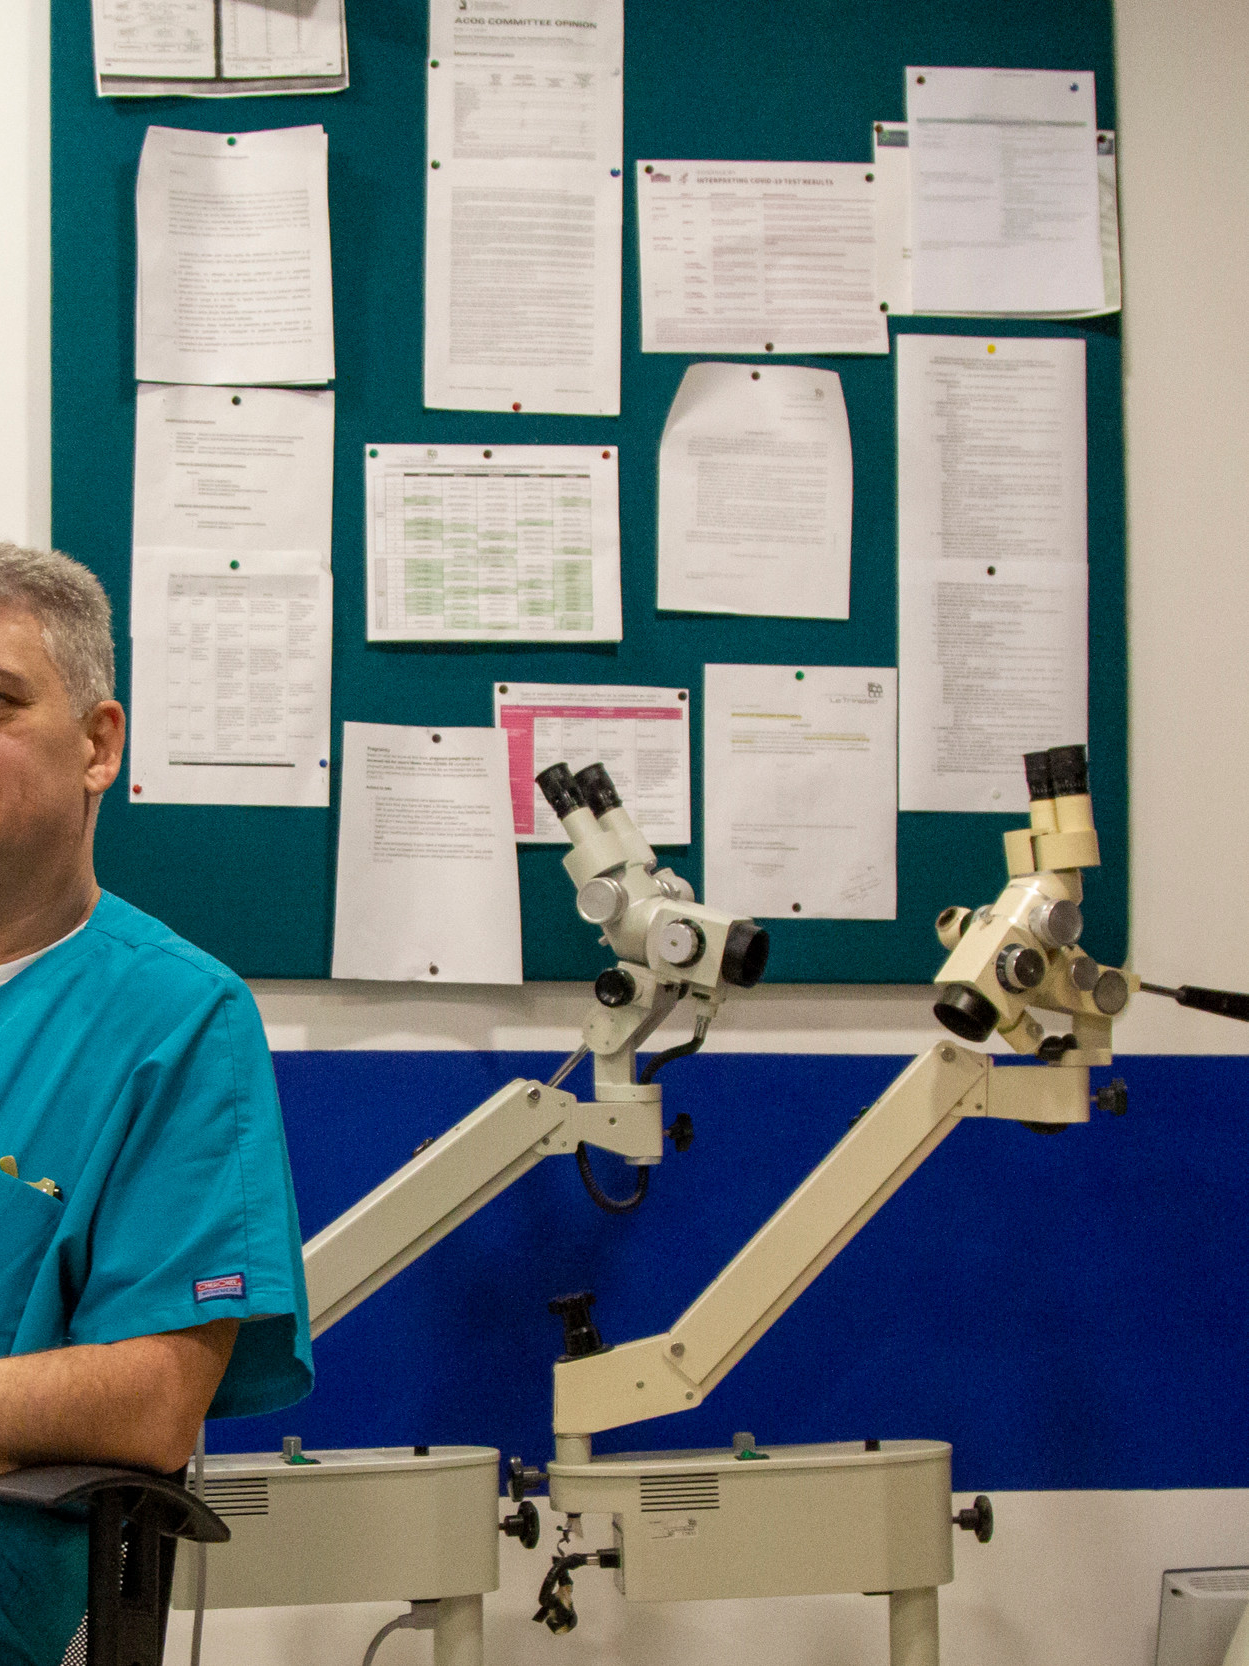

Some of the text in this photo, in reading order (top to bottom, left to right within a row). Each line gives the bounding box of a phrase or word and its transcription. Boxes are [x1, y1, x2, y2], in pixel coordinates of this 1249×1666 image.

[454, 16, 598, 29] ACOG COMMITTEE OPINION
